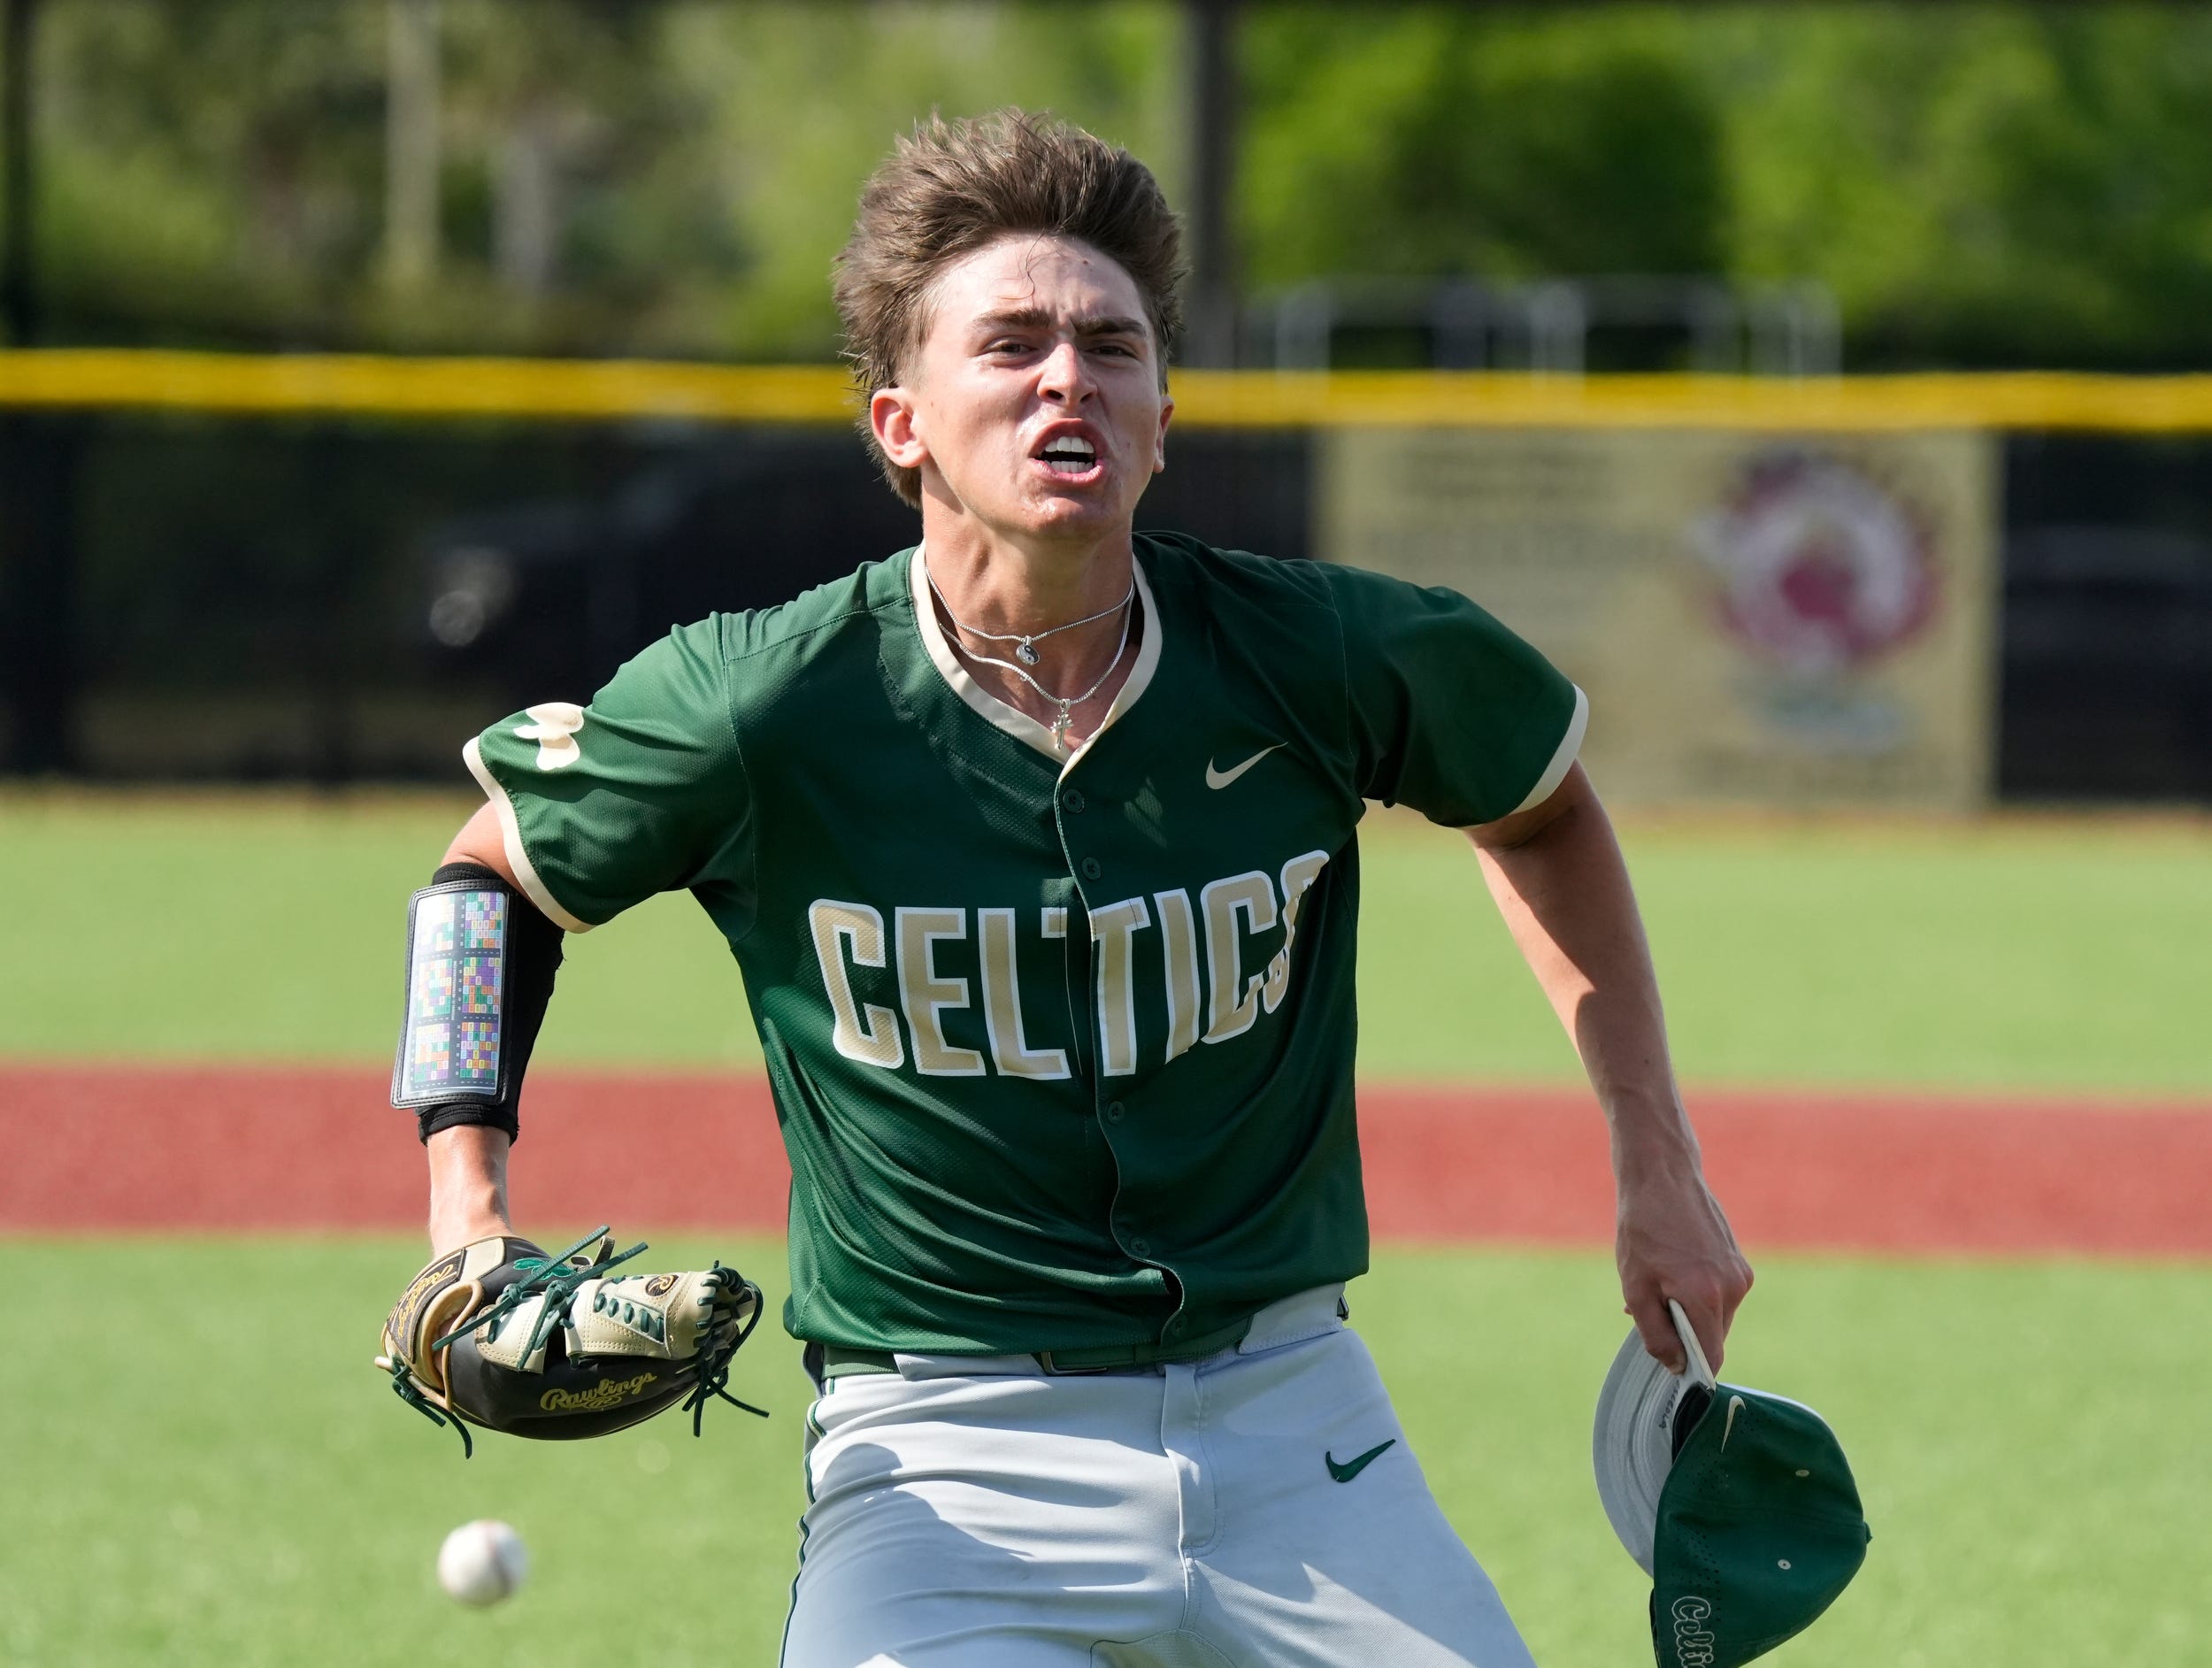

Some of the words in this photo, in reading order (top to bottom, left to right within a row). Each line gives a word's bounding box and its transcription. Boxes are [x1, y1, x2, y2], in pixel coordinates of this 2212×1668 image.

[809, 850, 1330, 1080] CELTICS
[541, 1372, 657, 1410] Rawlings
[1671, 1595, 1715, 1668] Celti
